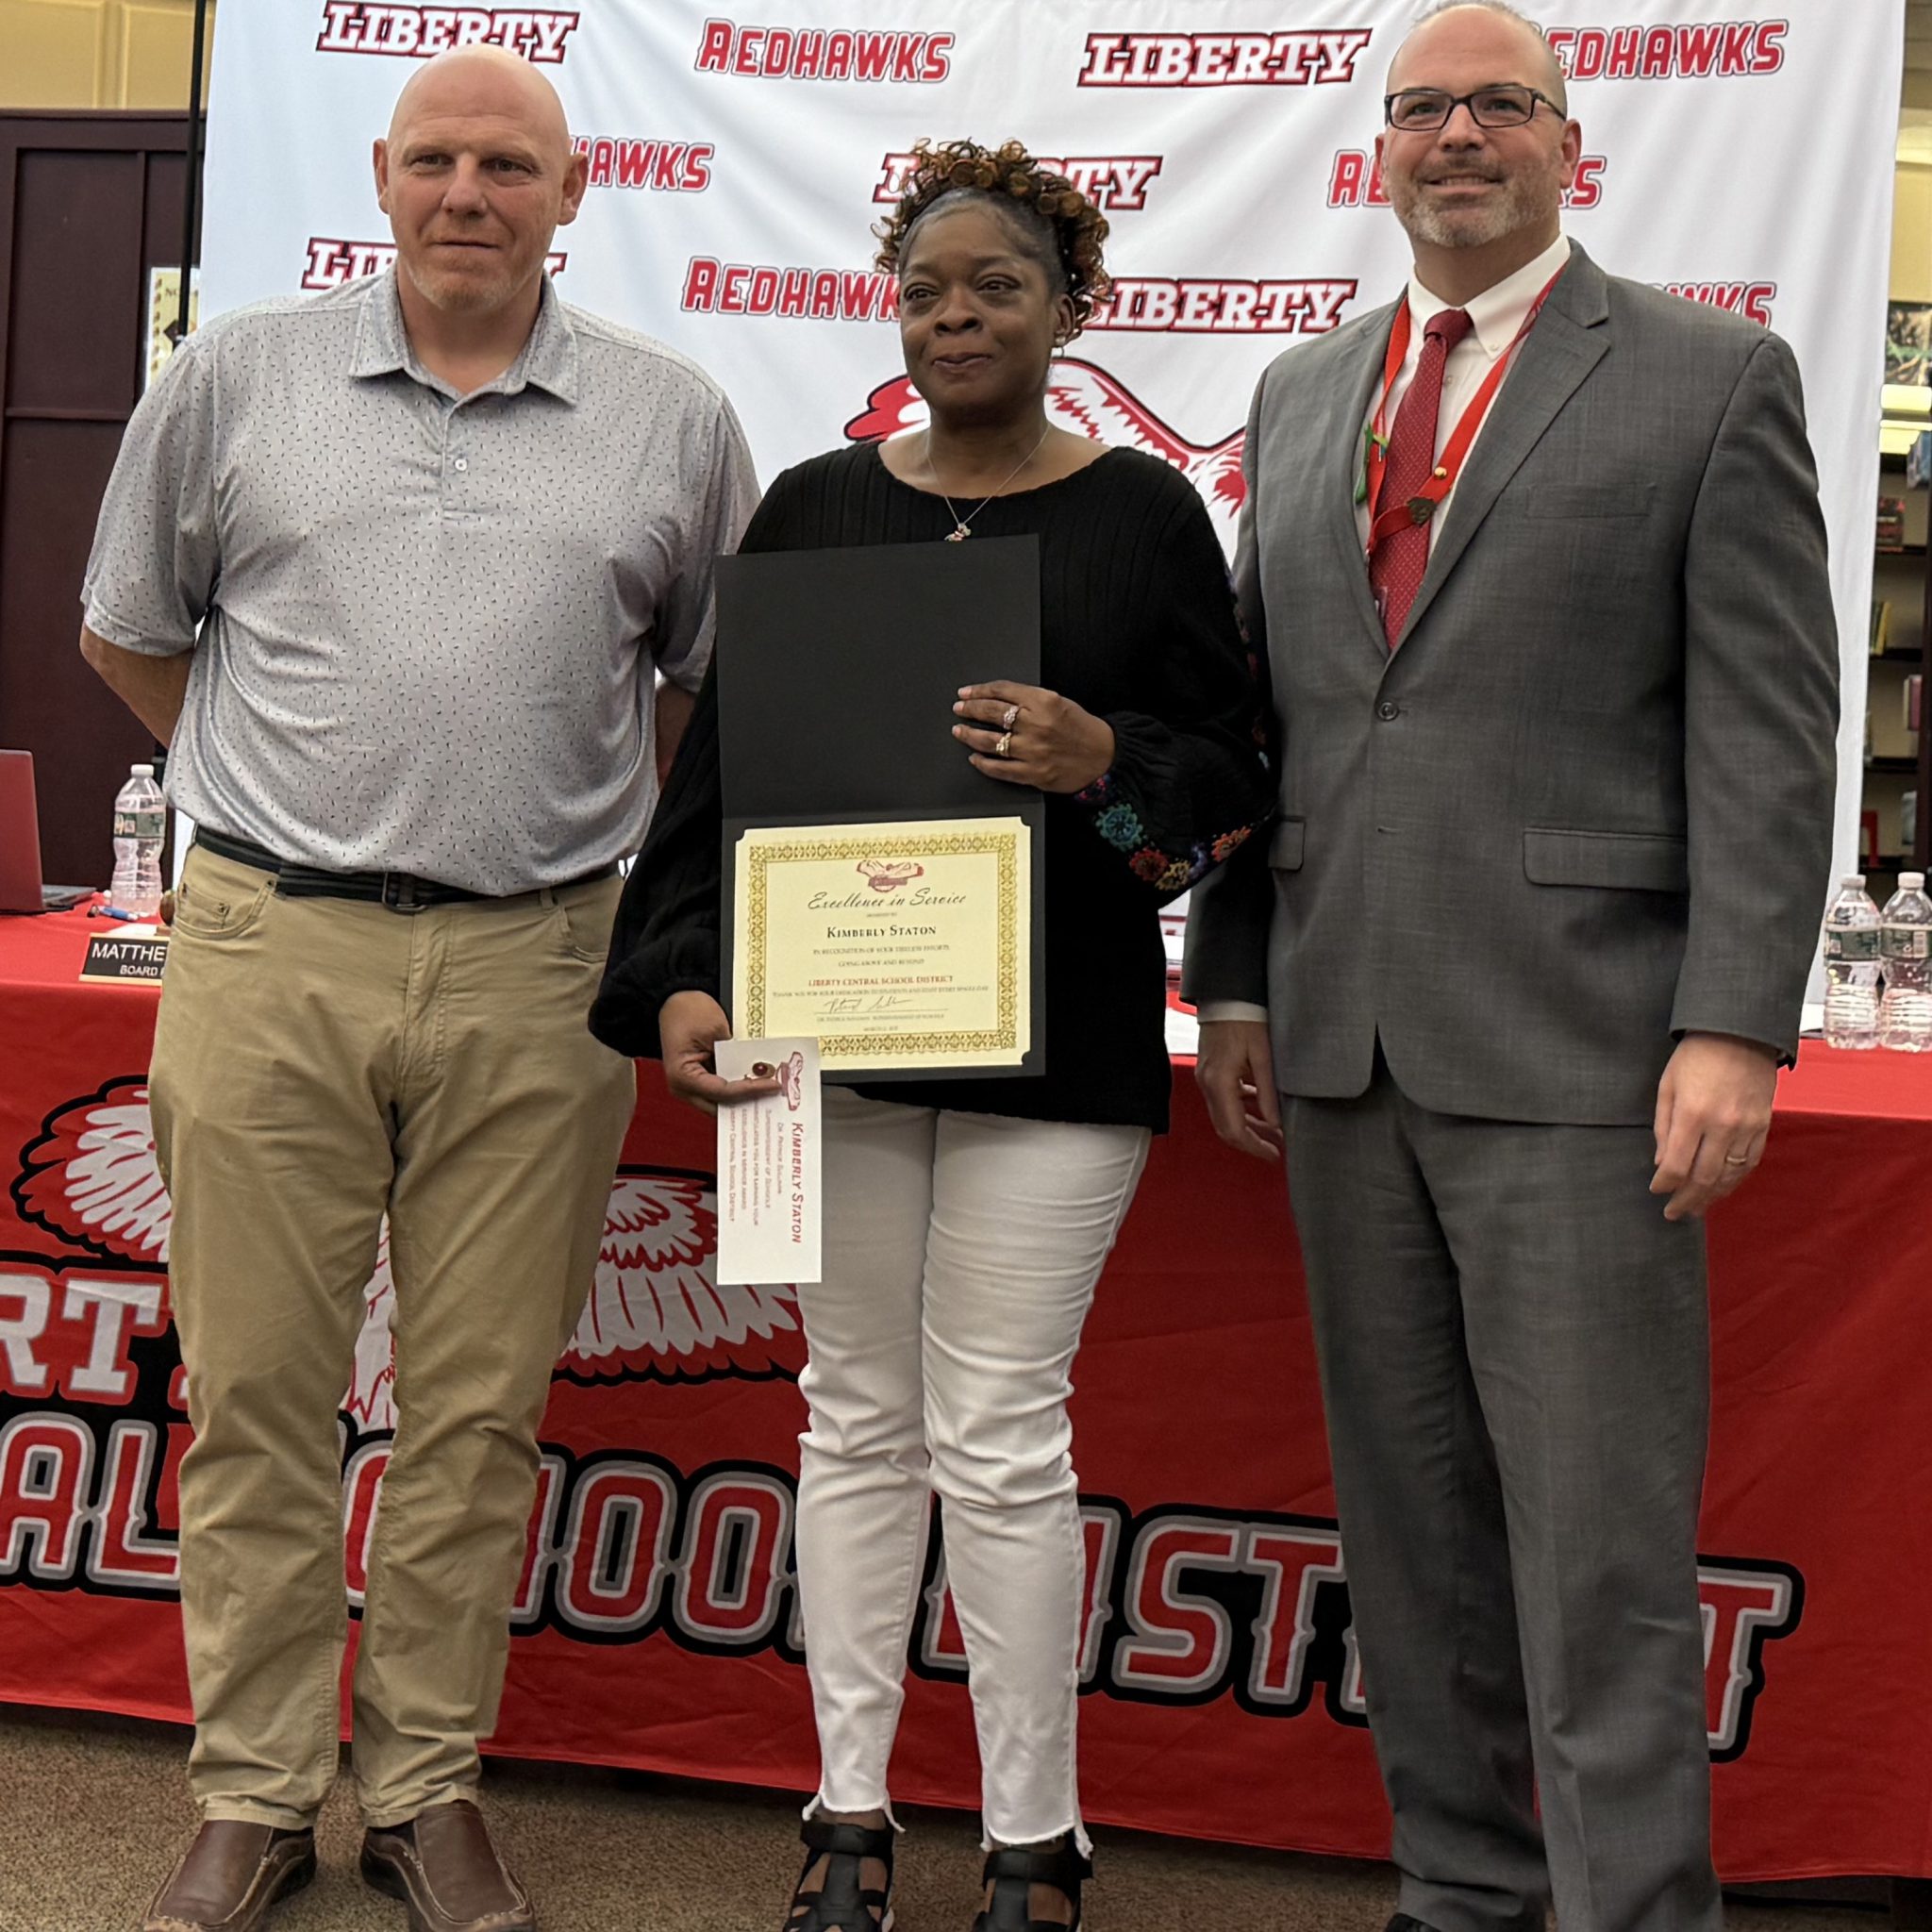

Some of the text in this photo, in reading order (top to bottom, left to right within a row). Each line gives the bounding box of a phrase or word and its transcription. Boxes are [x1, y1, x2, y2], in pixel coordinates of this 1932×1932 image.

[316, 0, 580, 63] LIBERTY
[1078, 29, 1372, 87] LIBERTY
[1538, 19, 1789, 80] EDHAWKS
[680, 256, 901, 324] REDHAWK
[807, 887, 967, 909] Excellence in Service
[92, 942, 167, 961] MATTHE
[826, 924, 937, 939] KIMBERLY STATON
[120, 964, 158, 976] BOARD
[791, 1122, 804, 1243] KIMBERLY STATON
